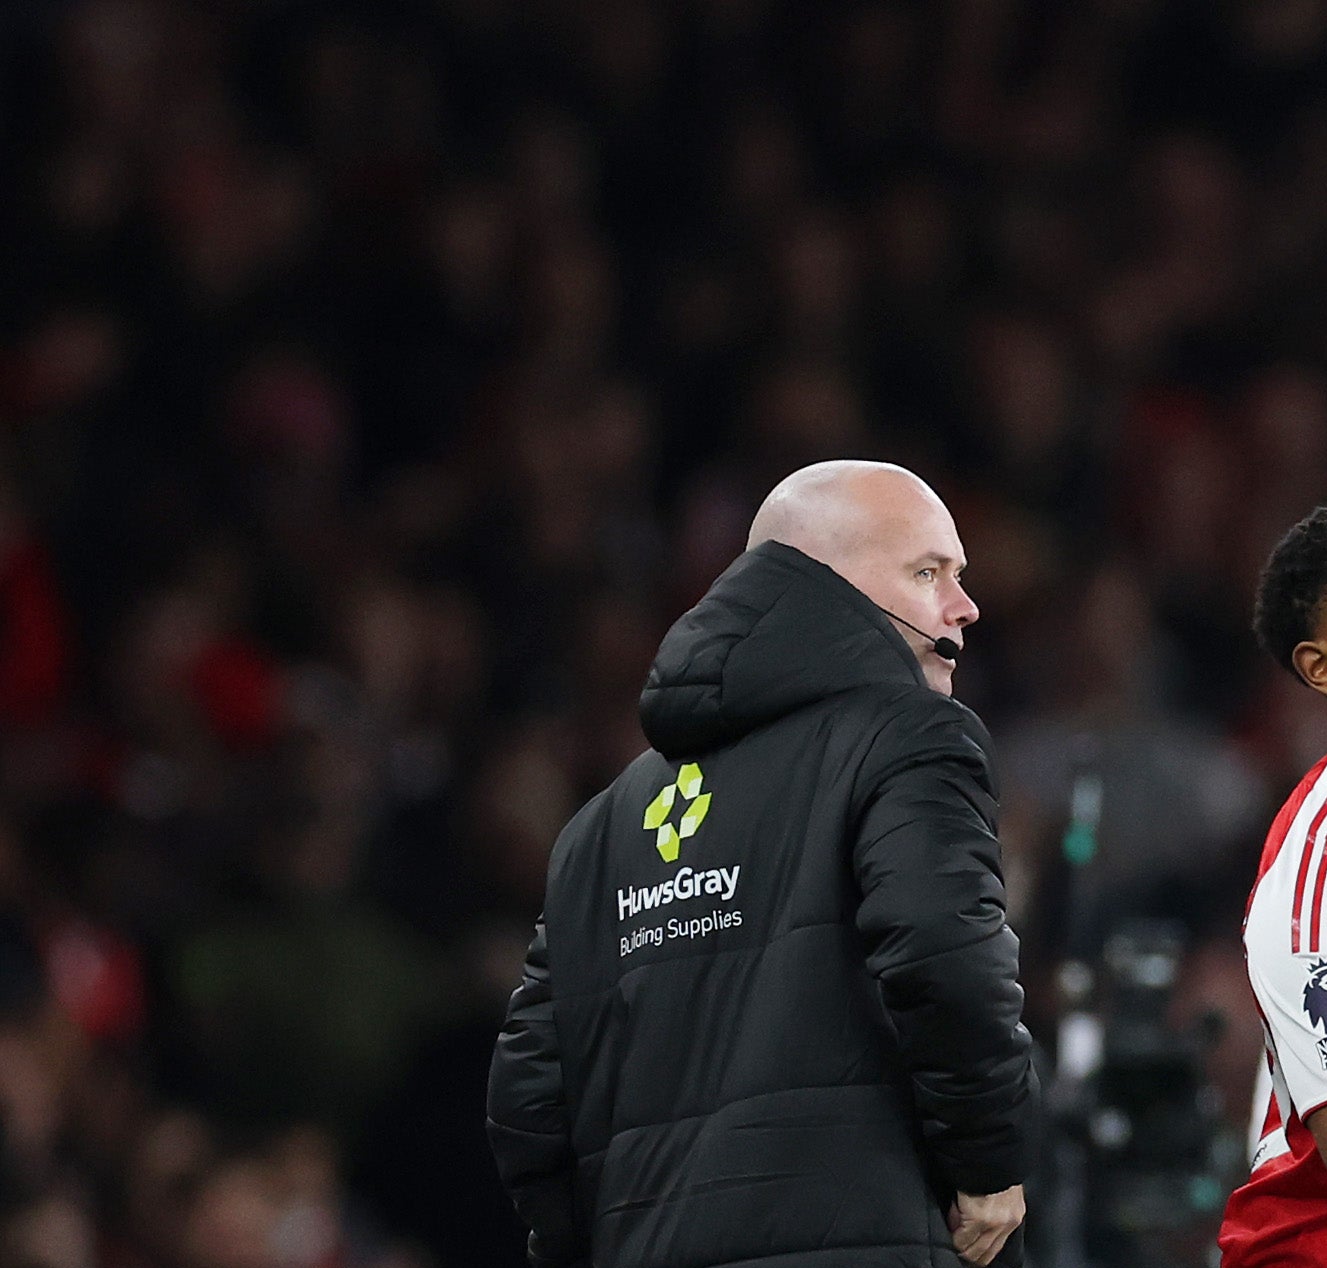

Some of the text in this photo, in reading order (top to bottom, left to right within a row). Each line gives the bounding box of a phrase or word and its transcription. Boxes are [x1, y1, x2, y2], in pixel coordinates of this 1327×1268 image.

[617, 865, 741, 922] HuwsGray
[620, 910, 743, 958] Building Supplies
